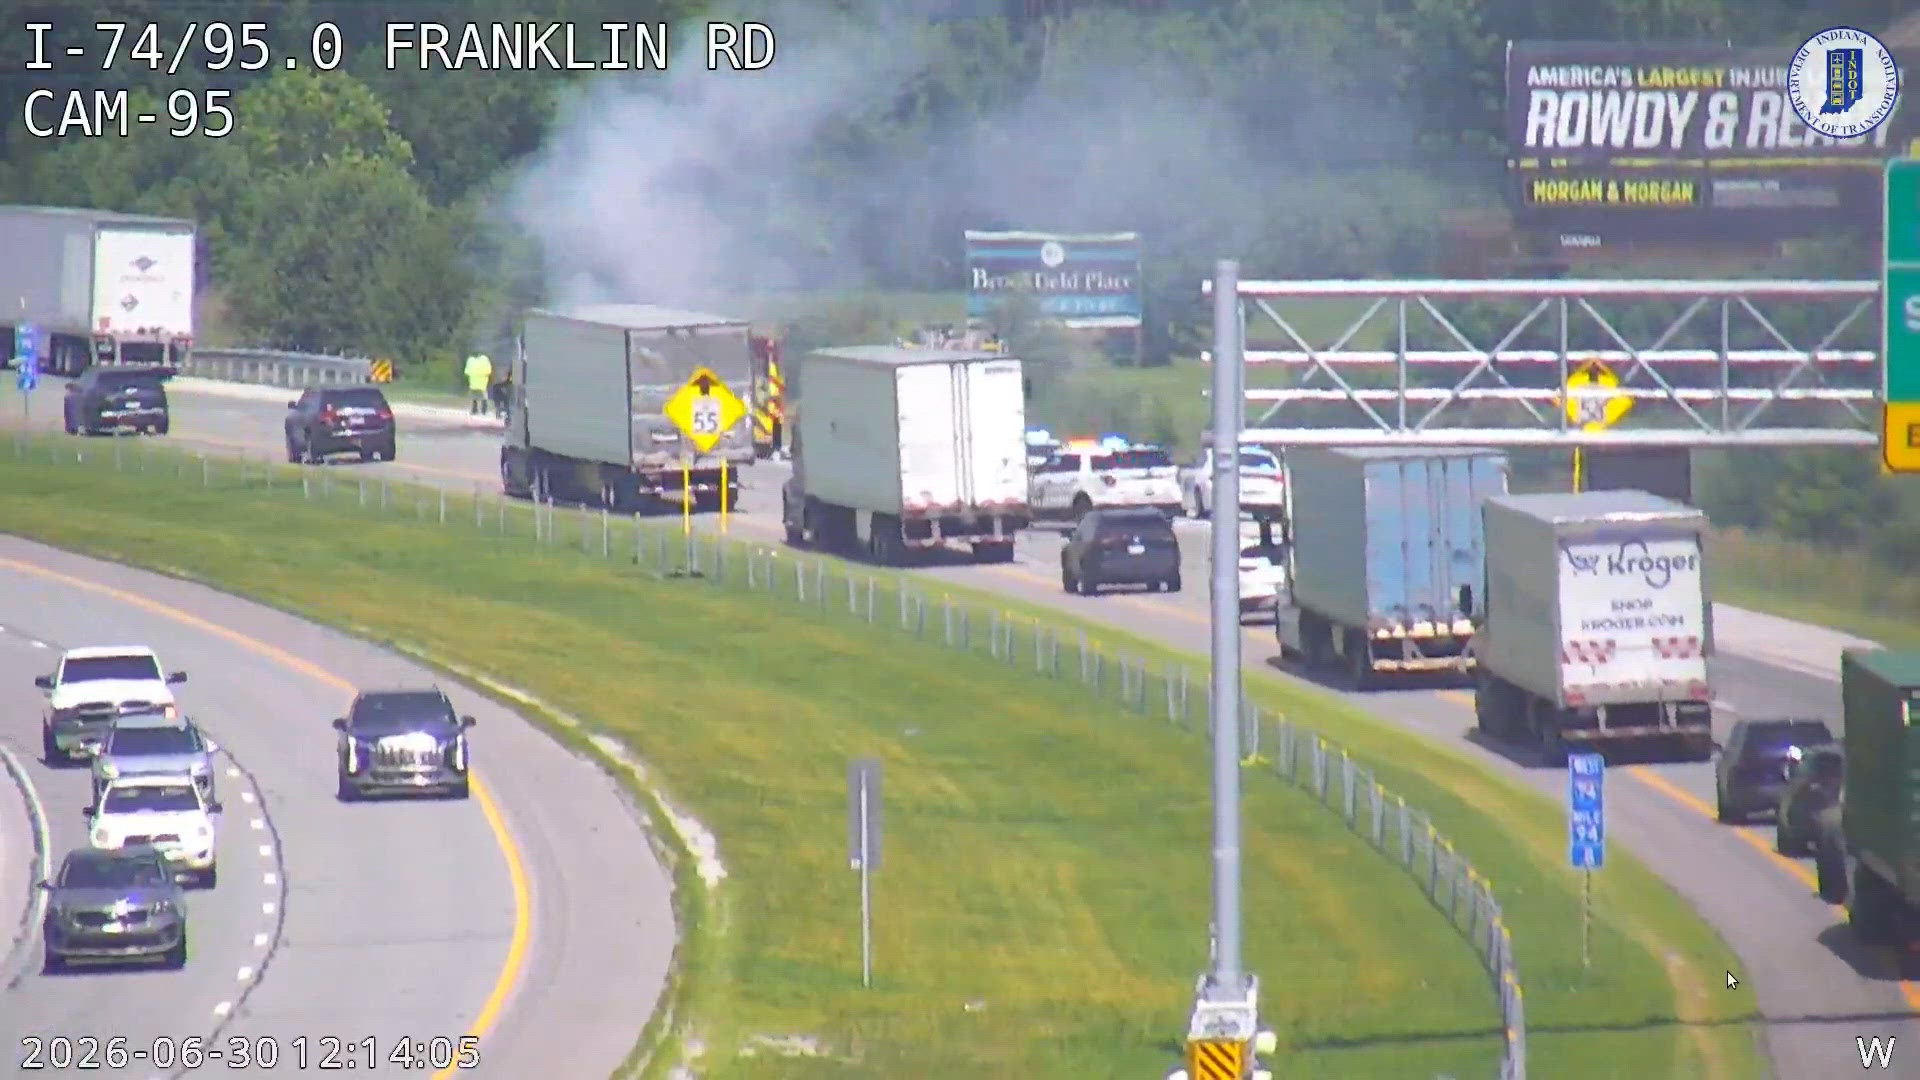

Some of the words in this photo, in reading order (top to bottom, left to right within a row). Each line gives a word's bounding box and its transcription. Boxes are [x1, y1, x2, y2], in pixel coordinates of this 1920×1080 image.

[1526, 64, 1633, 88] AMERICA'S
[1637, 66, 1725, 88] LARGEST
[1729, 67, 1789, 88] INJU
[1524, 89, 1700, 149] ROWDY
[1704, 90, 1739, 149] &
[1533, 179, 1603, 203] MORGAN
[1606, 179, 1620, 204] &
[1624, 180, 1694, 205] MORGAN
[1085, 270, 1131, 291] Place
[694, 411, 719, 433] 55
[1606, 538, 1696, 589] Kroger
